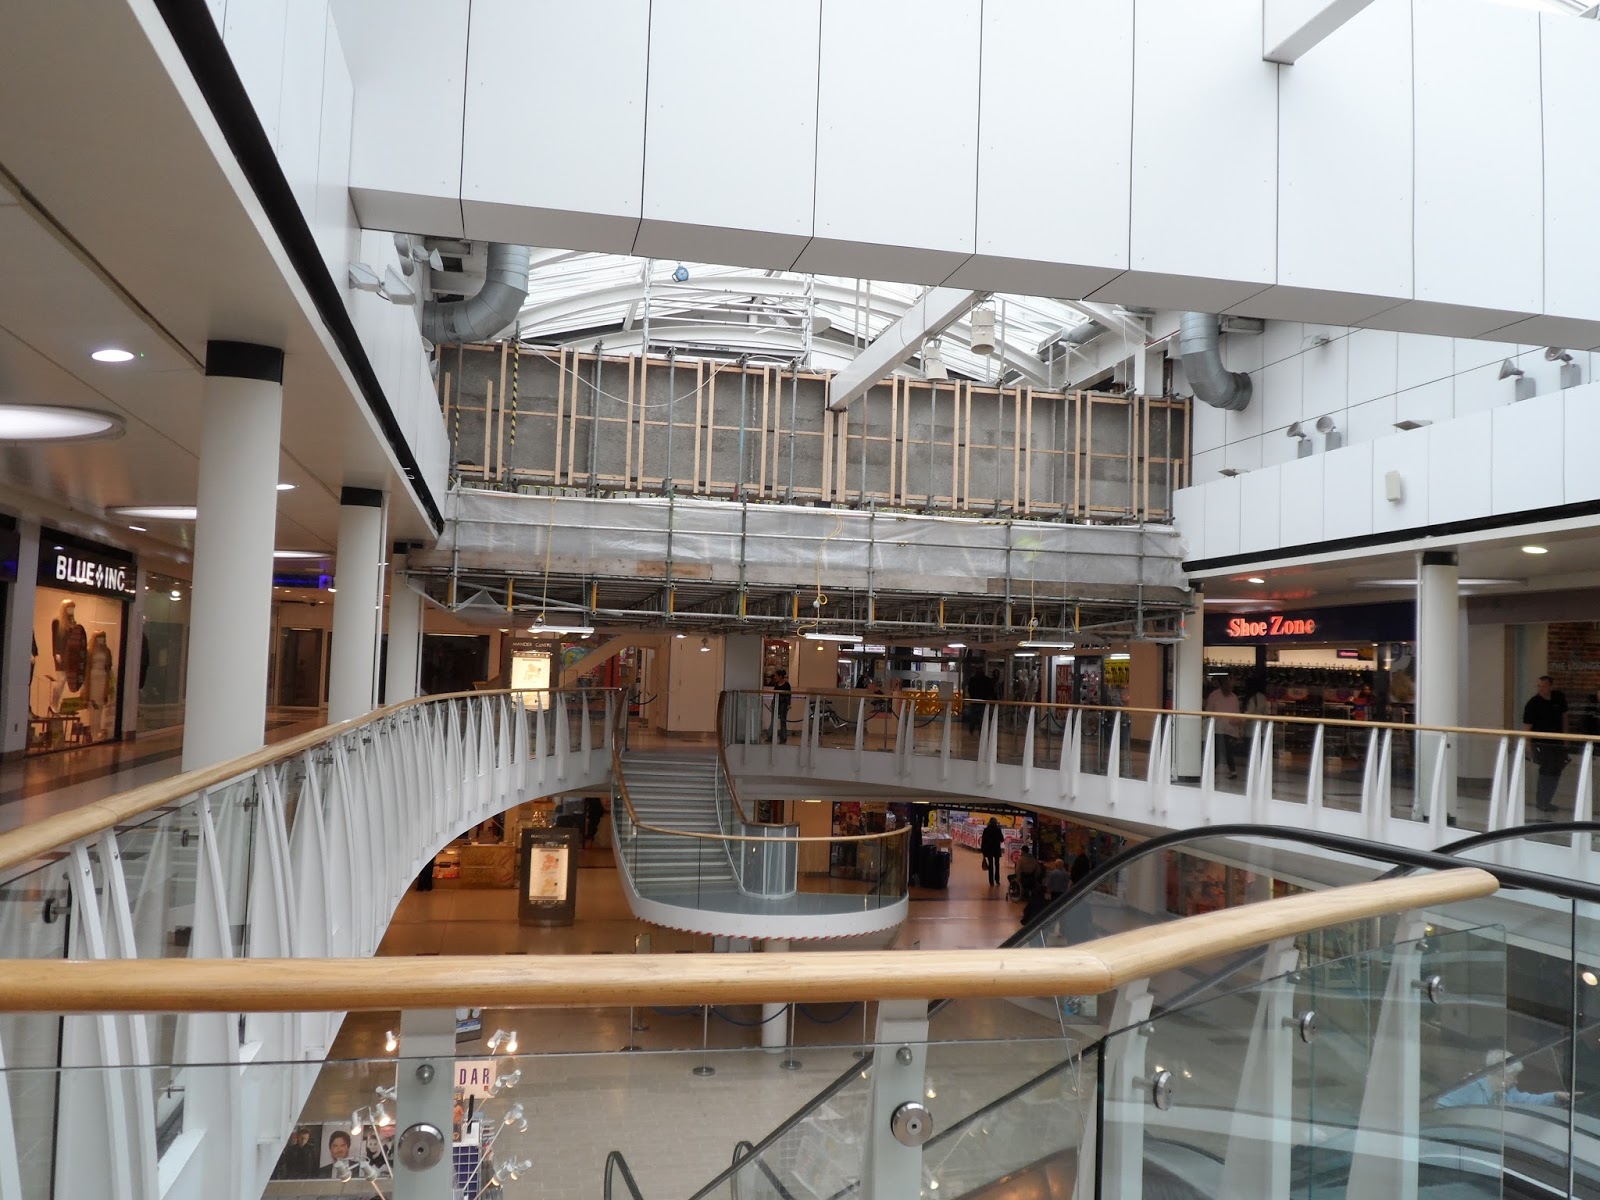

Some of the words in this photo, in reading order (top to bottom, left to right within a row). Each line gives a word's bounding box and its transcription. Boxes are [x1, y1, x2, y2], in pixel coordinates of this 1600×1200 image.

[55, 555, 95, 586] BLUE
[104, 567, 126, 591] INC
[1229, 617, 1268, 637] Shoe
[1269, 615, 1316, 636] Zone
